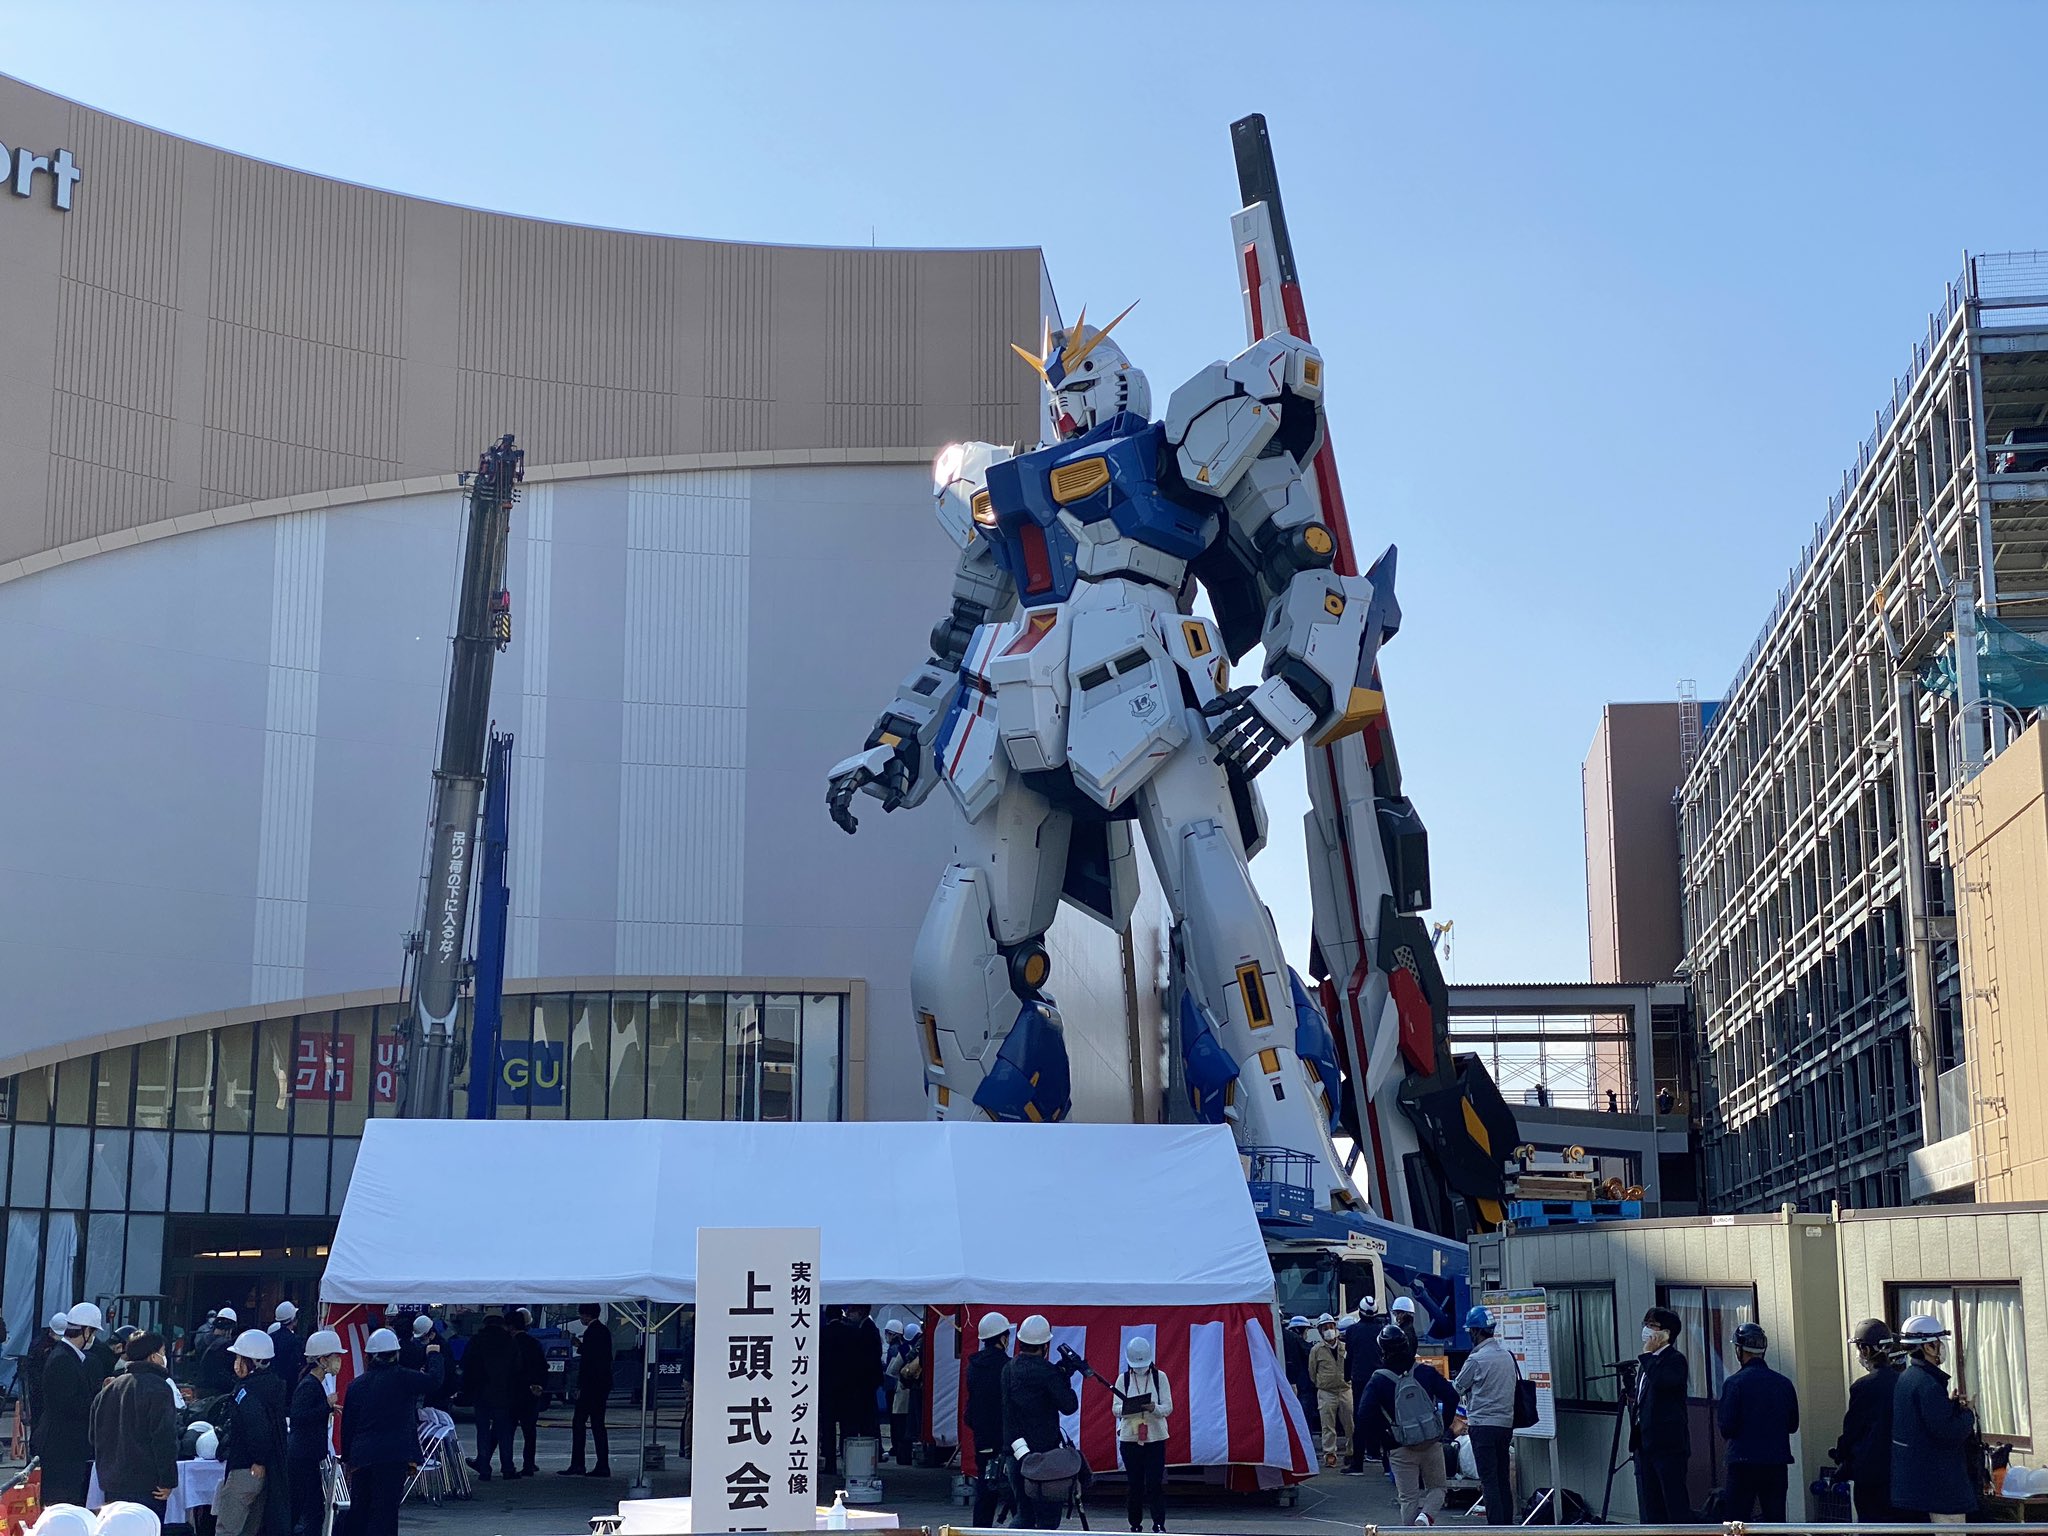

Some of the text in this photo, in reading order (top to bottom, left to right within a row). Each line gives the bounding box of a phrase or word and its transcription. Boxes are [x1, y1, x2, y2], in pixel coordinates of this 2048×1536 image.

[503, 1058, 559, 1088] GU
[725, 1270, 775, 1532] 上頭式会
